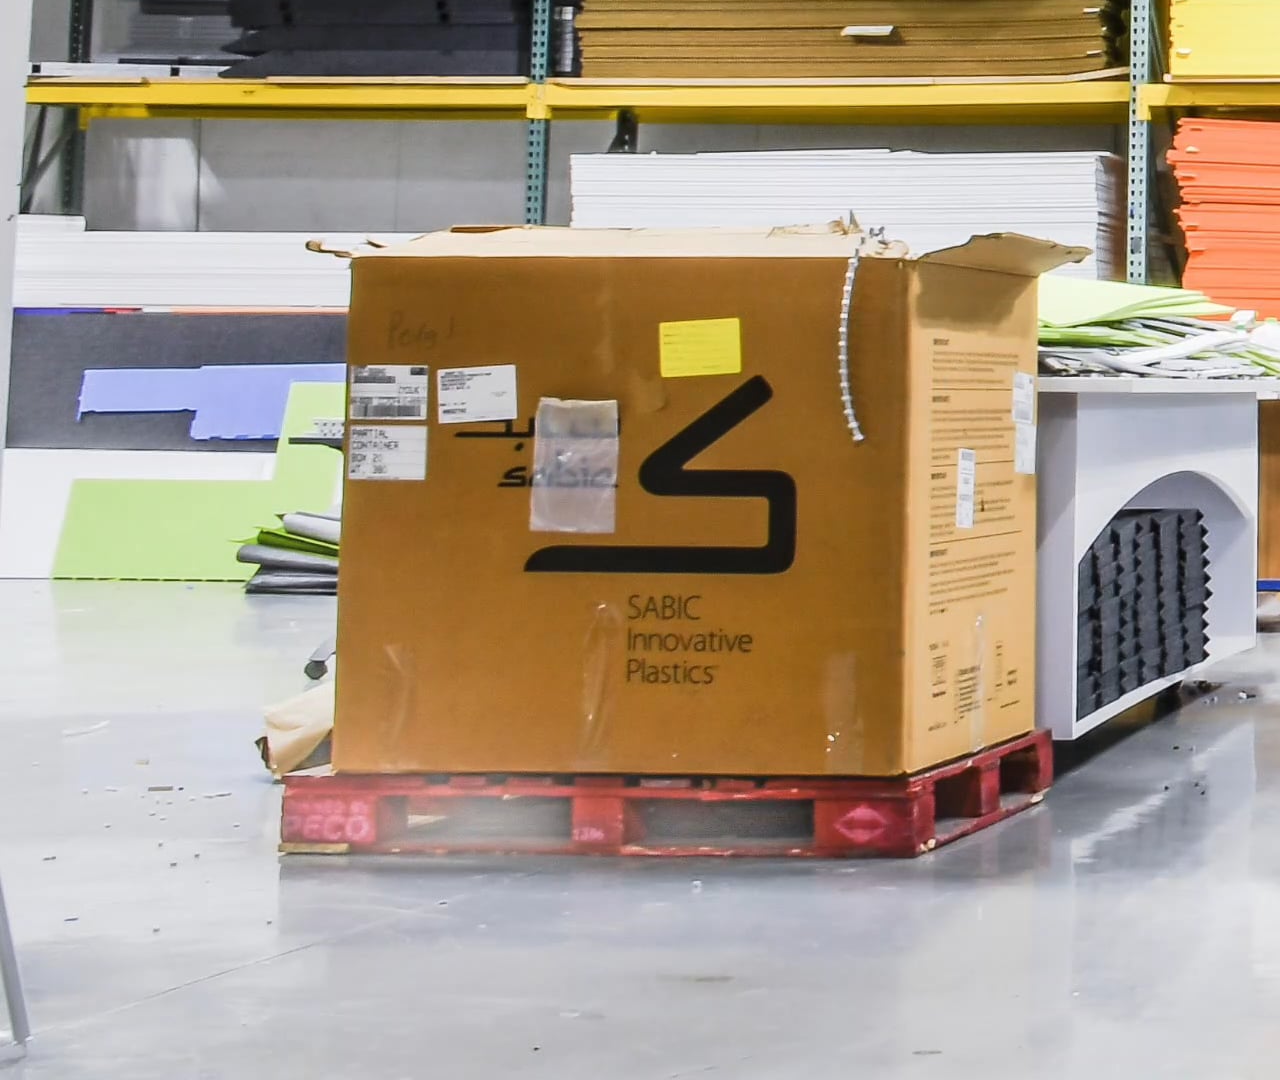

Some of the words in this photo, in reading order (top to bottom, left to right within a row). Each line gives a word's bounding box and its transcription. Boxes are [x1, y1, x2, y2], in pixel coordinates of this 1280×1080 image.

[352, 429, 388, 439] PARTIAL
[352, 440, 400, 450] CONTAINER
[628, 594, 702, 620] SABIC
[627, 628, 753, 653] Innovative
[626, 658, 715, 685] Plastics
